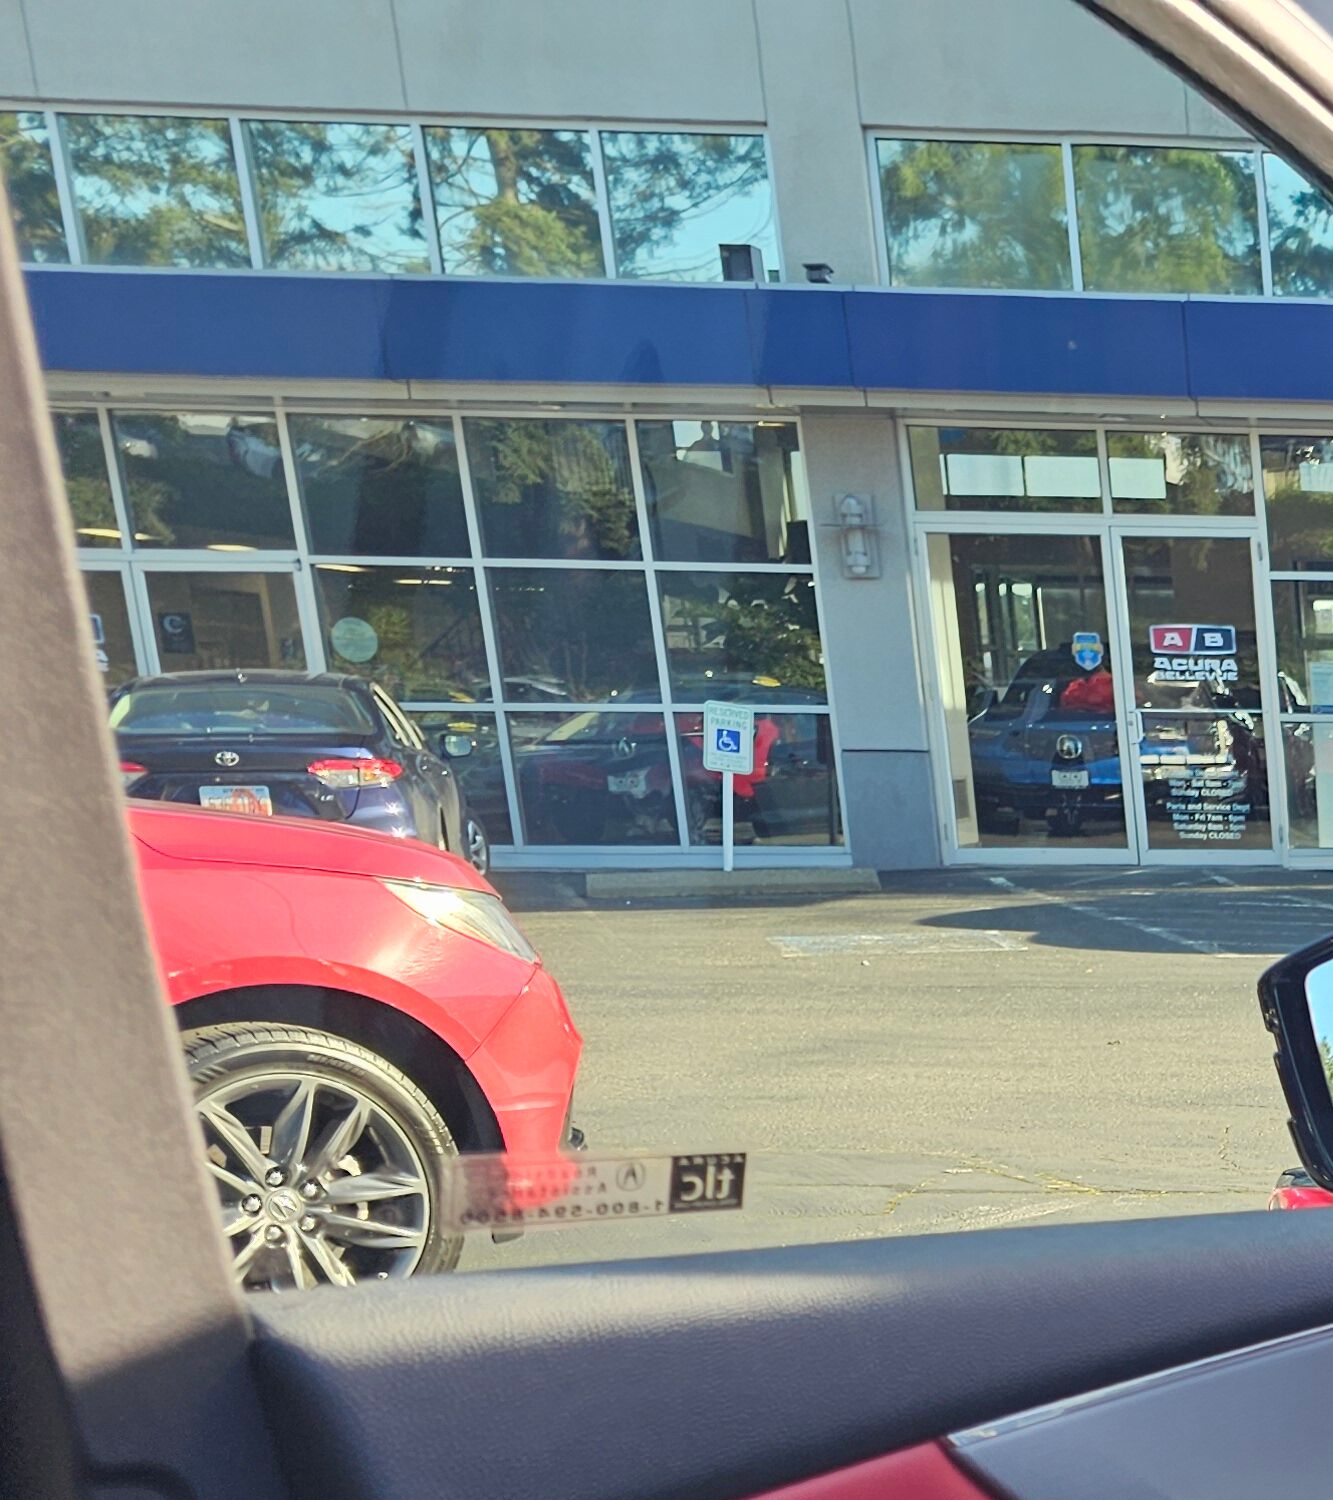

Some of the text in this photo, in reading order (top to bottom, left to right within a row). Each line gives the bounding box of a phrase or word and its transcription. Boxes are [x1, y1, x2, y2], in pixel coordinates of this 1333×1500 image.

[1162, 632, 1224, 647] A B
[1153, 657, 1239, 671] ACURA
[1155, 670, 1239, 682] BELLEVUE
[1166, 802, 1186, 810] Parts
[1203, 802, 1231, 810] Service
[1194, 813, 1206, 821] Fri
[1173, 822, 1206, 832] Saturday
[1178, 832, 1207, 840] Sunday
